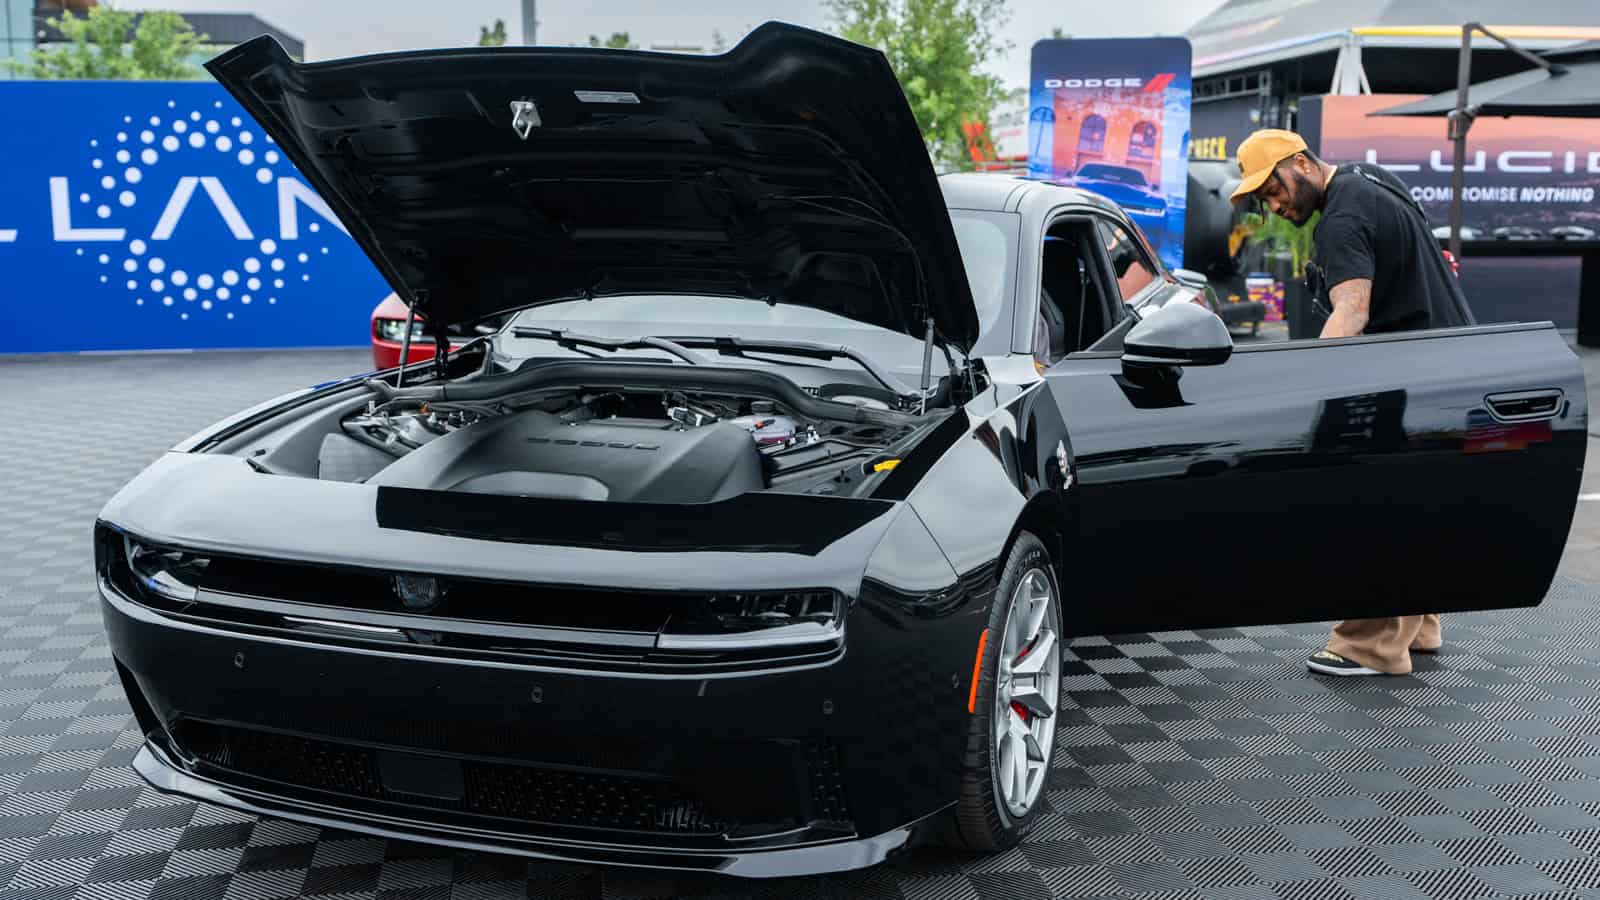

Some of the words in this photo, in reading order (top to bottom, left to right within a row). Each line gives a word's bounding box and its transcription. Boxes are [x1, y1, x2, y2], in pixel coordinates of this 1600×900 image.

[1044, 78, 1142, 88] DODGE
[1366, 149, 1600, 173] LUCI
[1410, 187, 1518, 202] COMROMISE
[1519, 187, 1594, 202] NOTHING
